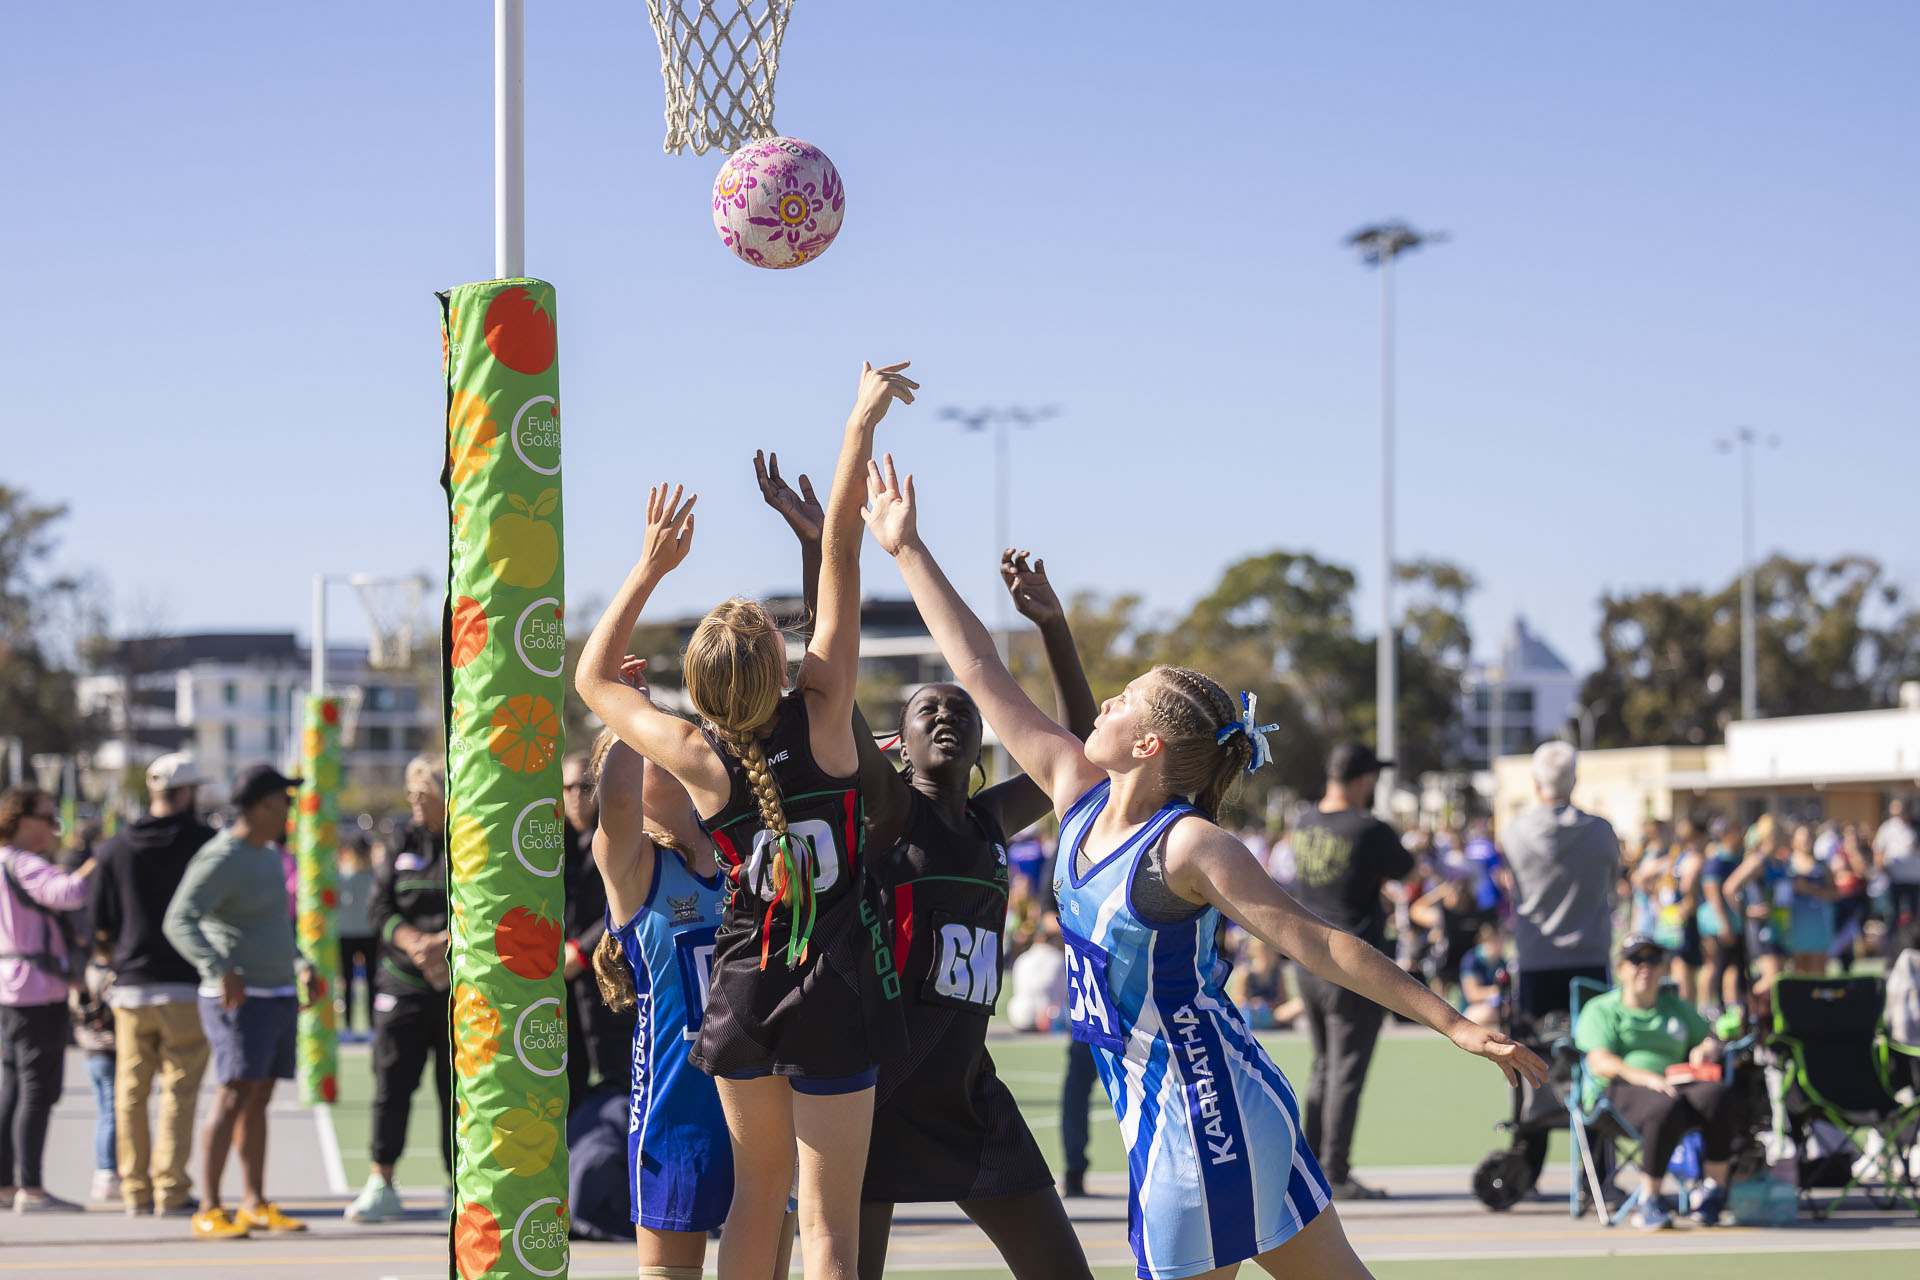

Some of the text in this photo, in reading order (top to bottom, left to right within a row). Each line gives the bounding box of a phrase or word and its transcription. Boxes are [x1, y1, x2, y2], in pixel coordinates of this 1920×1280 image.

[528, 416, 554, 432] Fuel
[531, 618, 558, 634] Fuel
[529, 819, 557, 834] Fuel
[1064, 943, 1112, 1035] GA
[530, 1019, 558, 1034] Fuel
[1172, 1003, 1237, 1165] KARRATHA
[530, 1217, 560, 1234] Fuel
